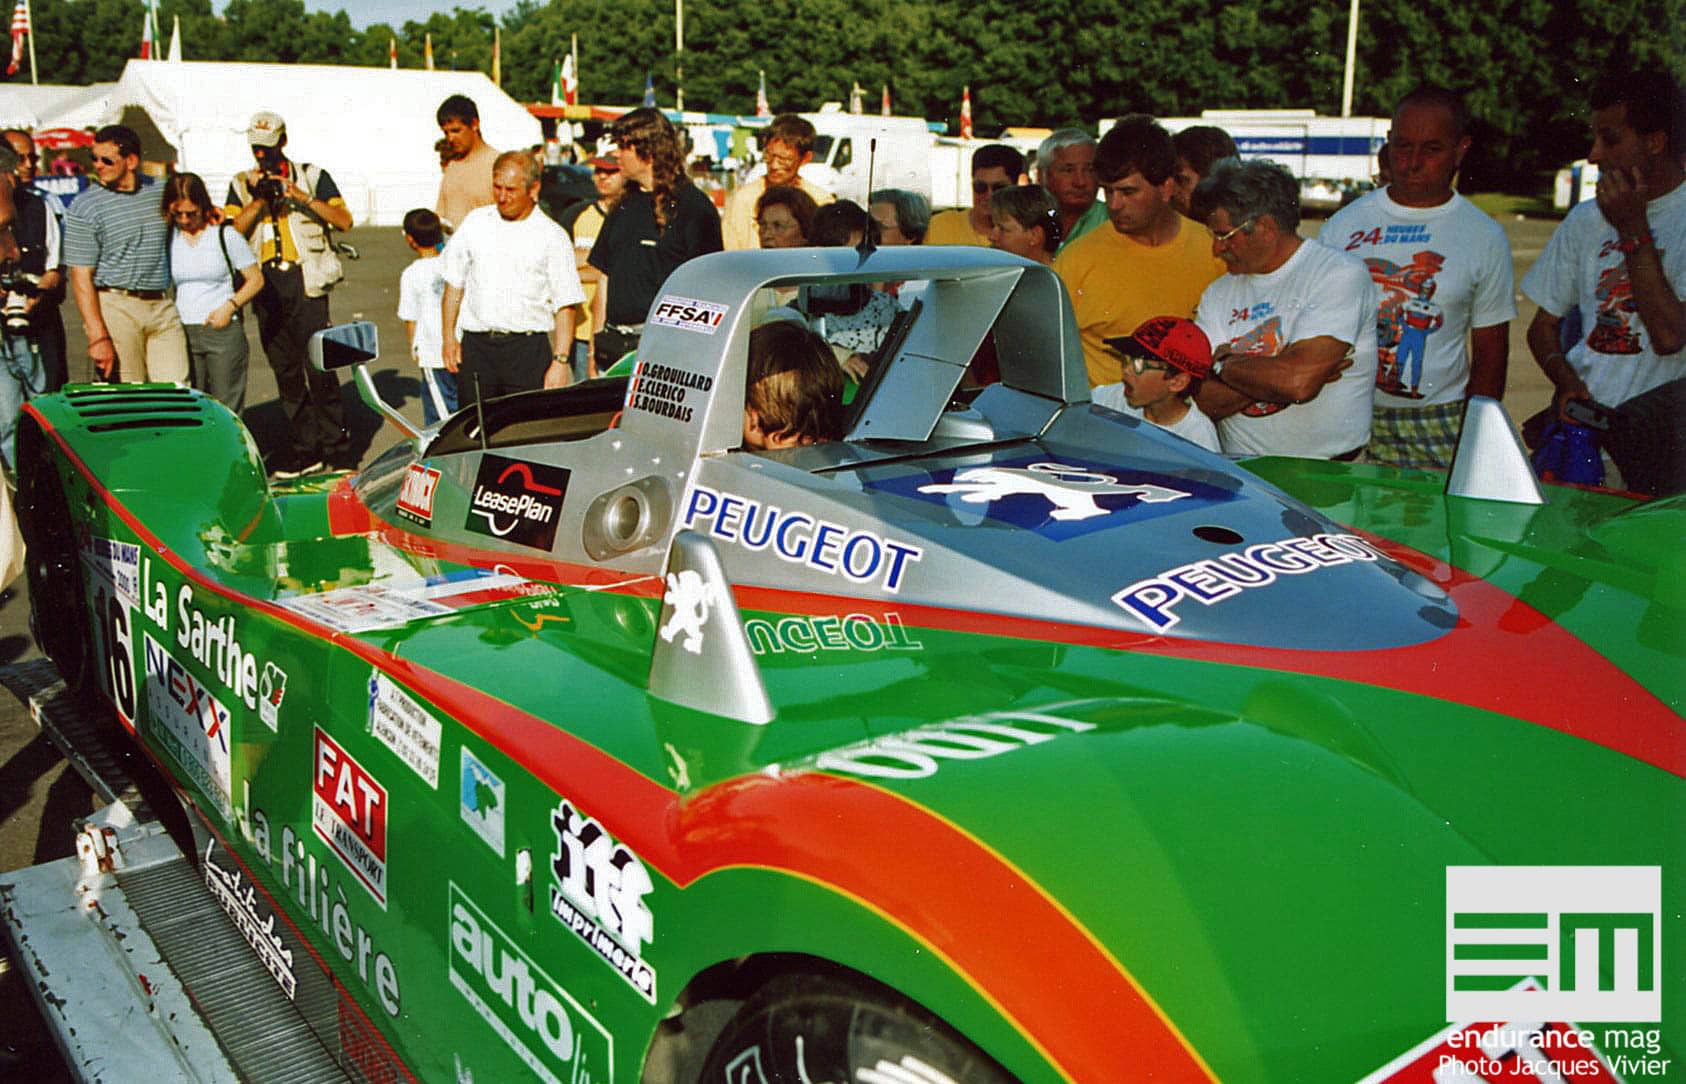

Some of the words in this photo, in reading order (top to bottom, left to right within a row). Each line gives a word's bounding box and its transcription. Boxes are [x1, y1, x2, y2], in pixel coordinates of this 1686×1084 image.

[1345, 227, 1382, 251] 24
[655, 303, 711, 324] FFSA
[633, 395, 693, 423] S.BOURDAIS
[637, 379, 686, 403] E.CLERICO
[642, 362, 713, 392] O.GROUILLARD
[474, 485, 553, 523] LeasePlan
[684, 488, 921, 591] PEUGEOT
[1113, 534, 1395, 631] PEUGEOT
[144, 557, 169, 631] La
[177, 584, 257, 710] Sarthe
[146, 635, 228, 755] NEXX
[318, 738, 380, 840] FAT
[331, 818, 383, 885] TRANSPORT
[281, 825, 400, 1018] filière
[553, 888, 653, 999] imprimerie
[452, 902, 574, 1062] auto
